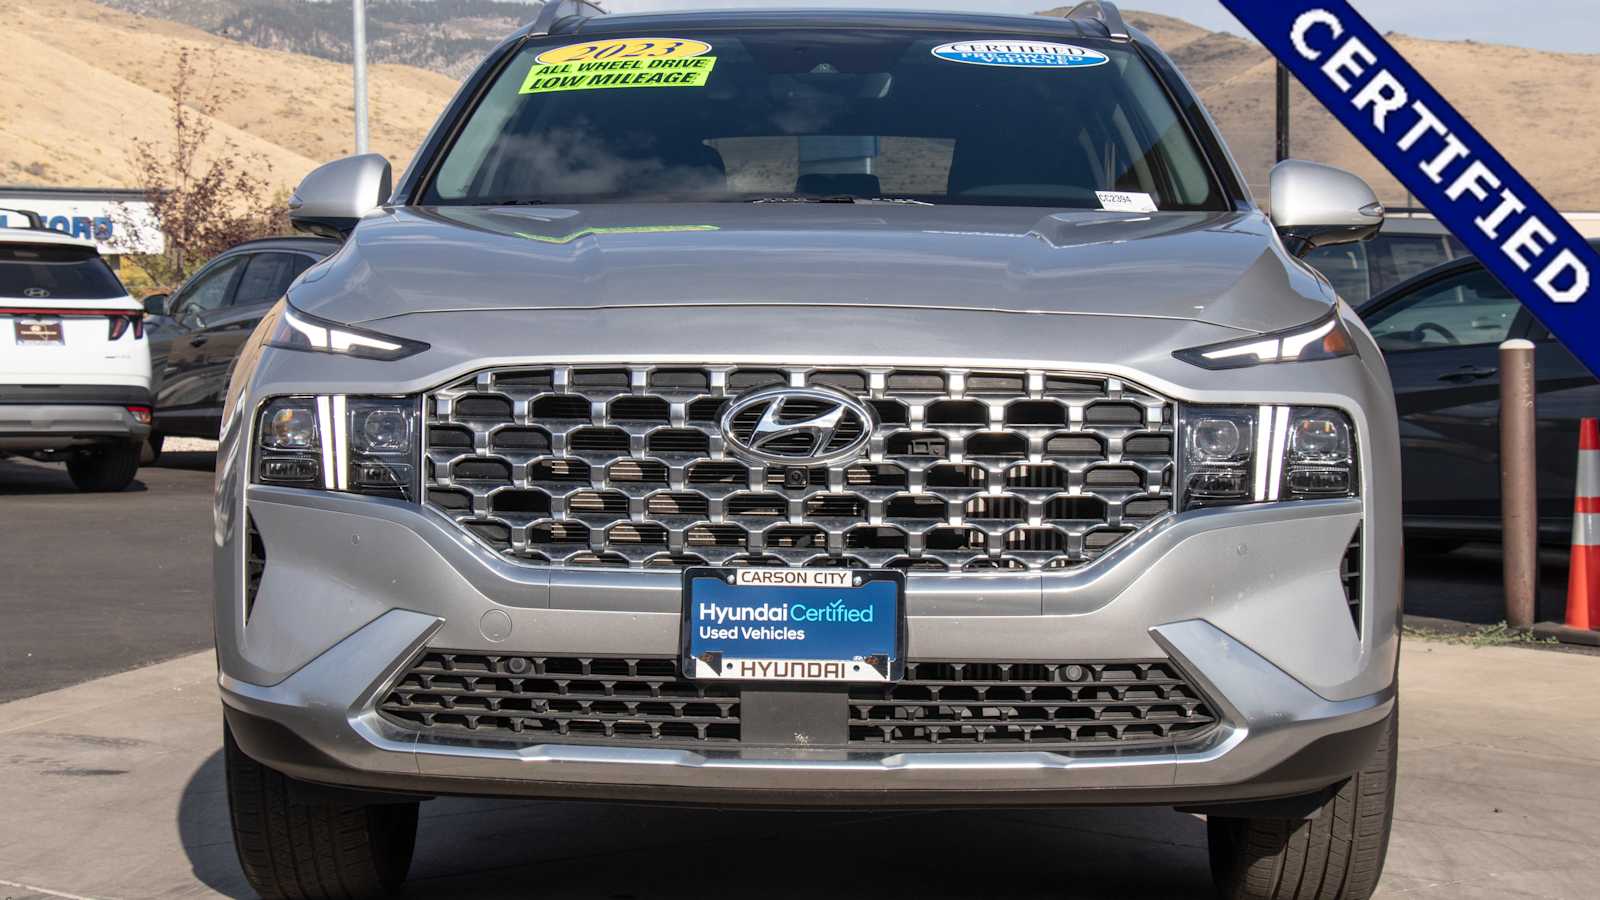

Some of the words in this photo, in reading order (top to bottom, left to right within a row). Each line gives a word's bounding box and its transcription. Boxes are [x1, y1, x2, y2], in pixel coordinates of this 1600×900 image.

[565, 42, 683, 61] 2023
[951, 43, 1086, 56] CERTIFIED
[535, 65, 570, 76] ALL
[577, 60, 641, 73] WHEEL
[647, 58, 708, 69] DRIVE
[984, 57, 1068, 65] VEHICLE
[529, 75, 586, 90] LOW
[586, 72, 697, 86] MILEAGE
[741, 571, 807, 584] CARSON
[814, 572, 848, 584] CITY
[699, 603, 788, 624] Hyundai
[790, 600, 874, 623] Certified
[699, 626, 738, 640] Used
[741, 626, 806, 640] Vehicles
[741, 661, 846, 679] HYUNDAI
